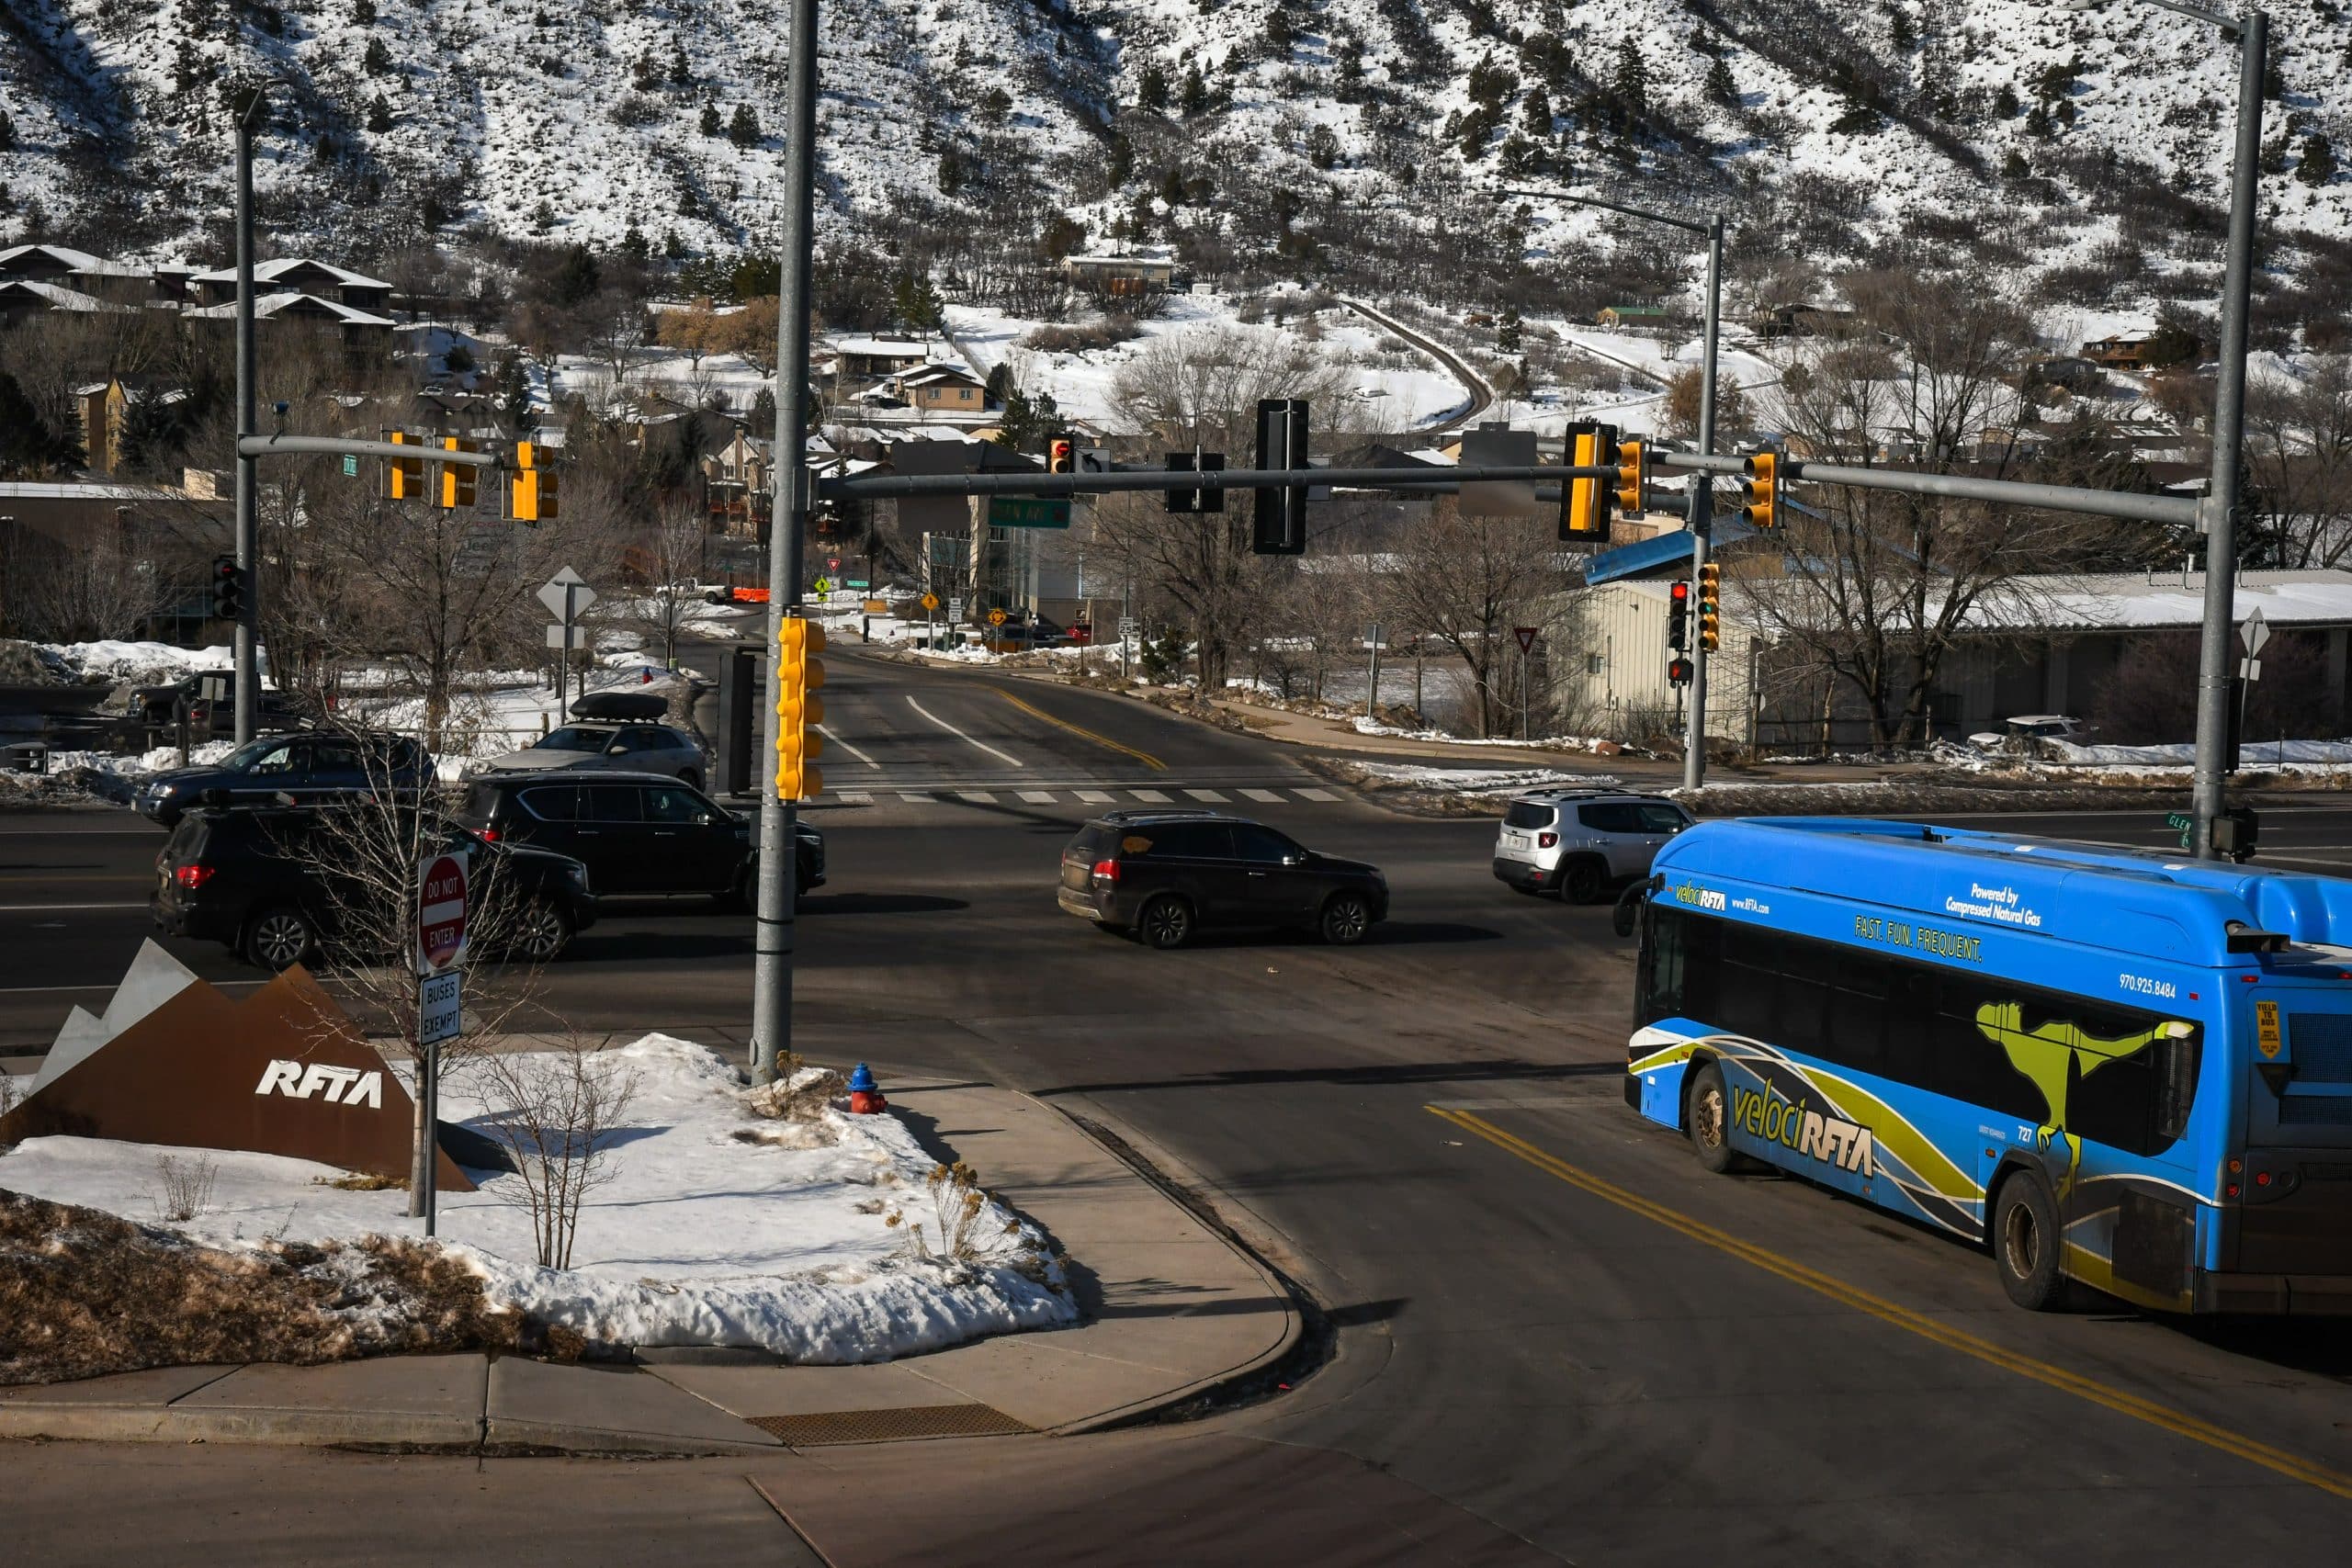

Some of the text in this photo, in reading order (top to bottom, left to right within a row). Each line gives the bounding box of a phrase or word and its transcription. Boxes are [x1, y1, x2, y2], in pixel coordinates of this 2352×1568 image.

[2168, 815, 2191, 831] GLEN
[428, 876, 458, 899] DO NOT
[1971, 883, 2018, 908] Powered by
[1732, 897, 1770, 915] www.RFTA.com
[1945, 897, 2041, 927] Compressed Natural Gas
[429, 926, 456, 949] ENTER
[1854, 915, 1983, 964] FAST. FUN. FREQUENT.
[427, 981, 456, 1005] BUSES
[2120, 973, 2177, 999] 970.925.8484
[2256, 1003, 2278, 1011] YIELD
[424, 1010, 458, 1036] EXEMPT
[254, 1058, 382, 1110] RFTA
[2018, 1124, 2033, 1144] 727
